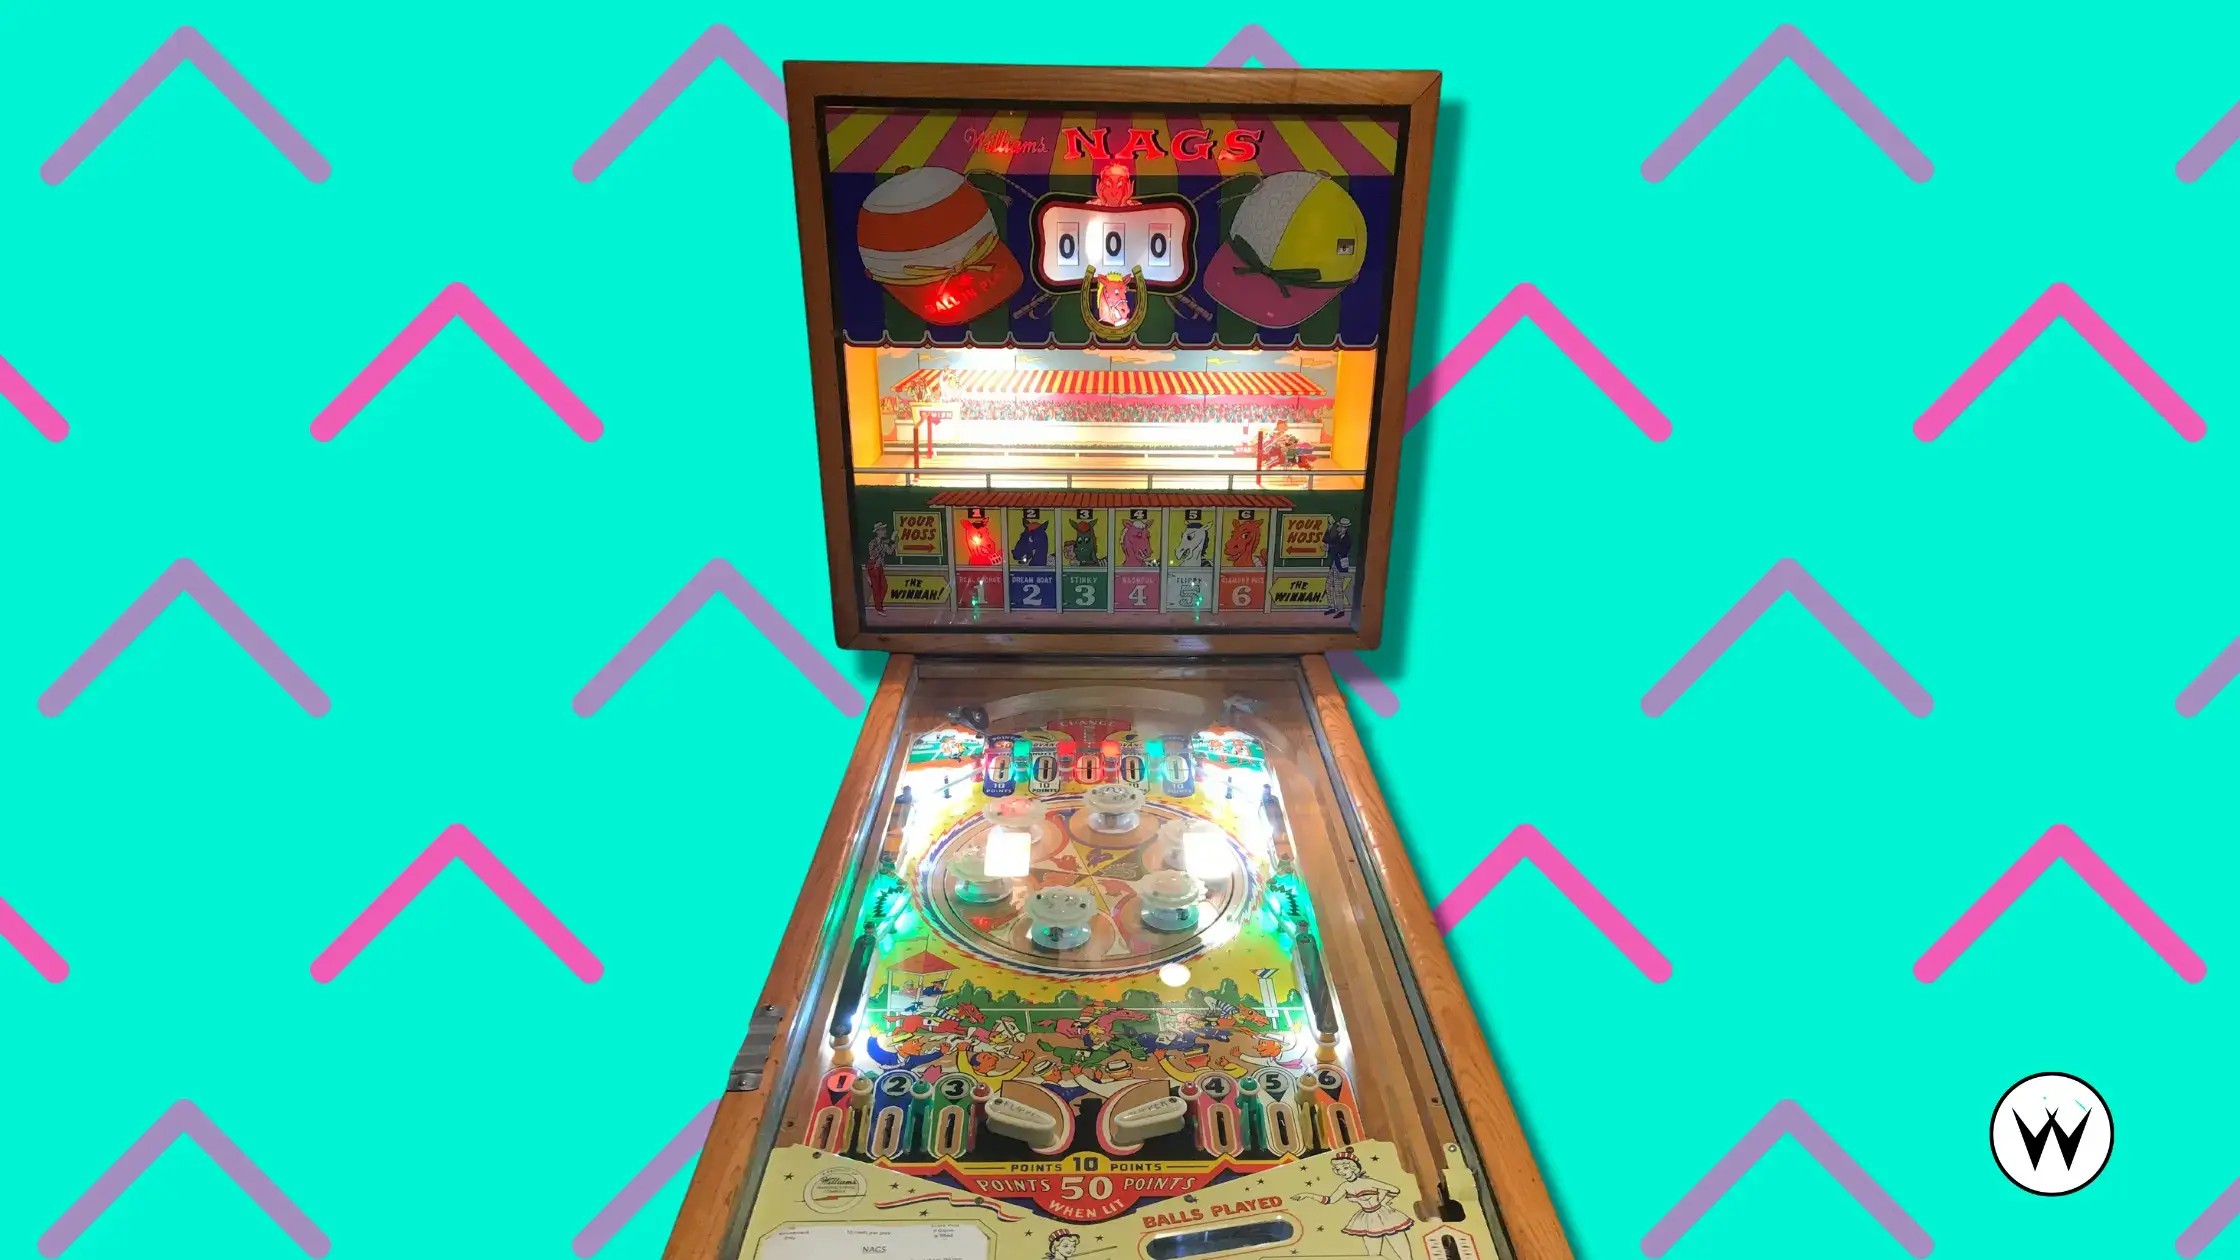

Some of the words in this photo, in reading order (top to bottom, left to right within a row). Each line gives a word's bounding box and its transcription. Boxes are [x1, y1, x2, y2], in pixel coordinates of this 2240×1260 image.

[1062, 126, 1264, 162] NAGS
[1059, 233, 1075, 259] 0
[1105, 231, 1122, 257] 0
[1150, 233, 1167, 258] 0
[972, 508, 981, 517] 1
[1026, 509, 1036, 518] 2
[1080, 510, 1090, 518] 3
[1134, 511, 1144, 519] 4
[1188, 511, 1198, 519] 5
[1241, 511, 1251, 519] 6
[900, 515, 935, 527] YOUR
[1288, 519, 1323, 530] YOUR
[900, 528, 936, 540] HOSS
[1287, 531, 1323, 543] HOSS
[905, 578, 923, 587] THE
[1012, 576, 1034, 584] DREAM
[1290, 581, 1308, 590] THE
[891, 587, 944, 600] WINNAH!
[974, 582, 988, 604] 1
[1022, 584, 1042, 606] 2
[1075, 585, 1096, 606] 3
[1128, 585, 1147, 606] 4
[1179, 584, 1201, 607] 5
[1231, 585, 1252, 607] 6
[1275, 590, 1327, 603] WINNAH!
[836, 1075, 846, 1088] 1
[1205, 1078, 1225, 1093] 4
[1265, 1074, 1282, 1089] 5
[1317, 1071, 1336, 1086] 6
[886, 1079, 907, 1093] 2
[945, 1081, 964, 1095] 3
[1011, 1163, 1062, 1172] POINTS
[1072, 1157, 1099, 1172] 10
[1110, 1163, 1162, 1171] POINTS
[976, 1178, 1051, 1192] POINTS
[1060, 1176, 1113, 1200] 50
[1123, 1177, 1196, 1190] POINTS
[1049, 1200, 1097, 1218] WHEN
[1101, 1198, 1125, 1215] LIT
[1142, 1208, 1204, 1229] BALLS
[1210, 1195, 1283, 1218] PLAYED
